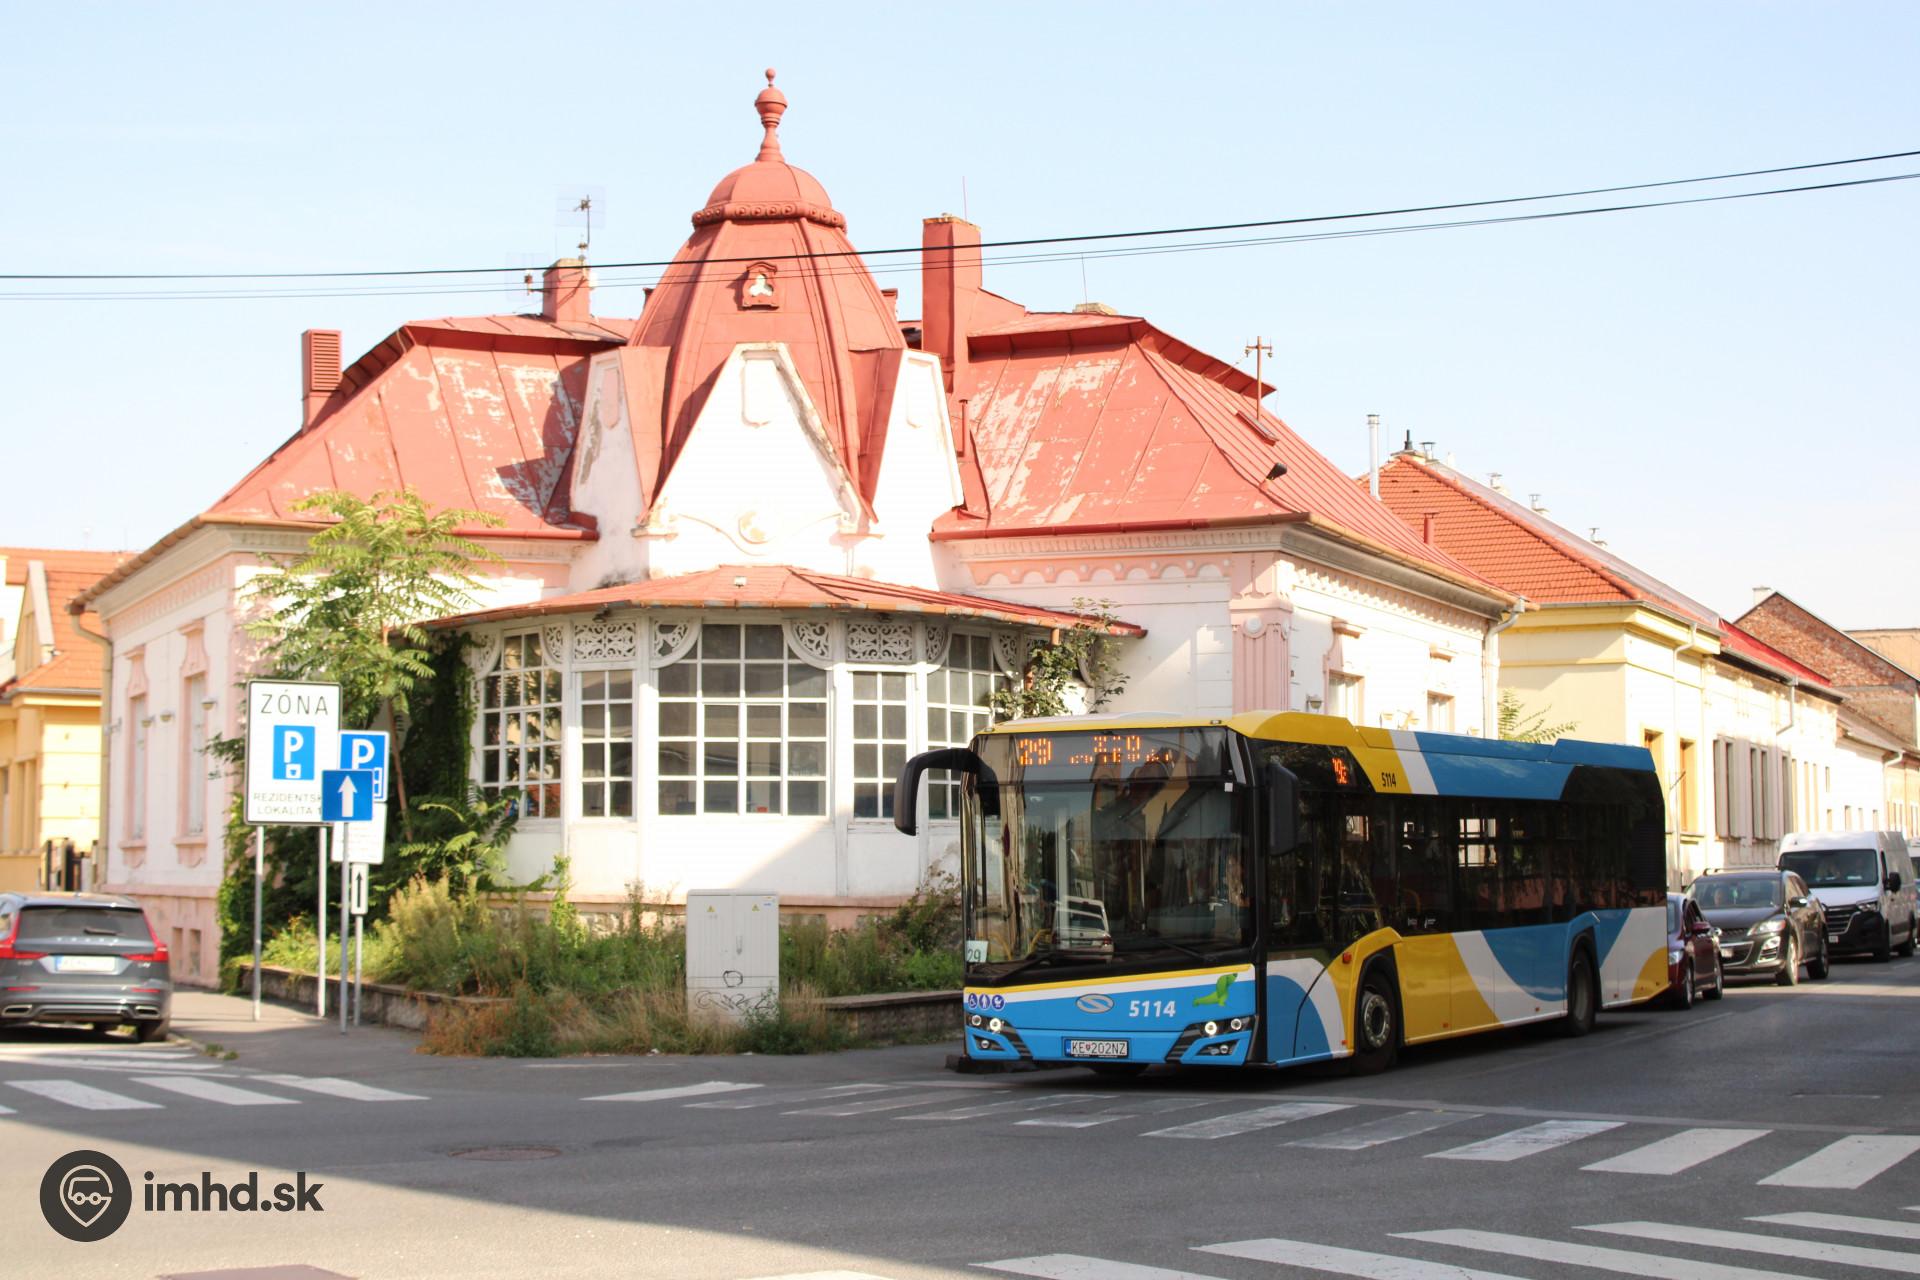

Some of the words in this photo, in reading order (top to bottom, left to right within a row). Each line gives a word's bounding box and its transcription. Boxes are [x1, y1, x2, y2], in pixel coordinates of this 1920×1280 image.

[261, 689, 329, 715] ZÓNA
[283, 730, 304, 763] P
[352, 739, 375, 769] P
[1381, 772, 1397, 788] 5114
[257, 806, 313, 816] LOKALITA
[967, 948, 982, 962] 29
[1128, 999, 1177, 1018] 5114
